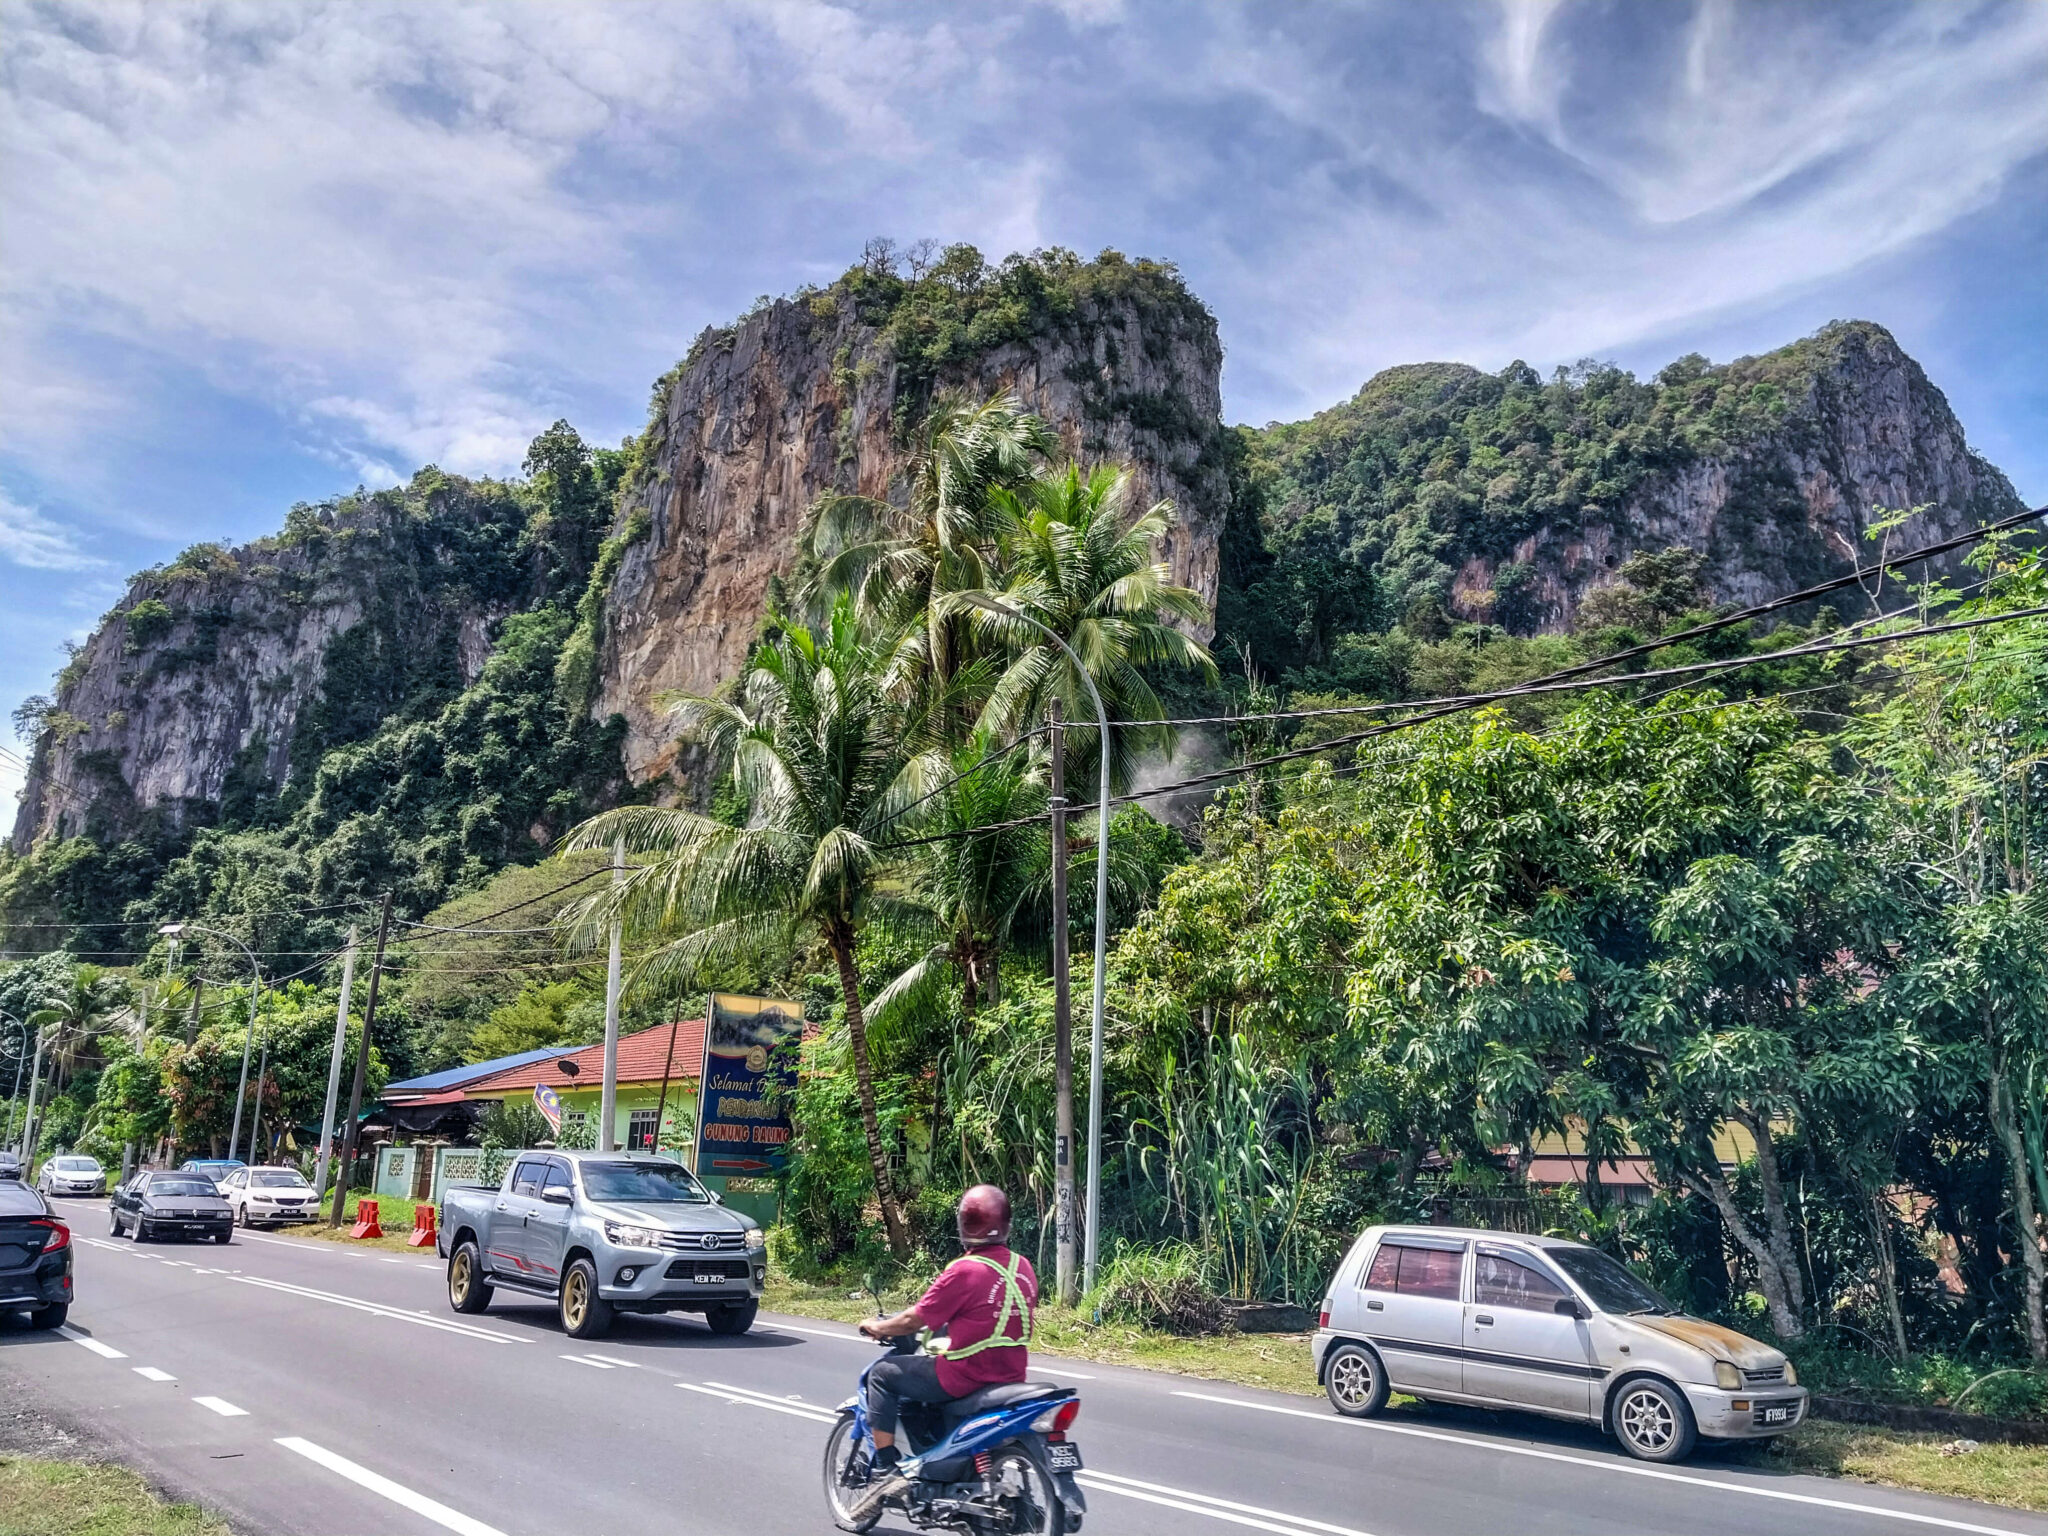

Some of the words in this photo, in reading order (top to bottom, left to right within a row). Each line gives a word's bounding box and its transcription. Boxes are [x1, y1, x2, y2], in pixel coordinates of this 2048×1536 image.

[708, 1072, 754, 1092] Selamat
[756, 1077, 798, 1095] Dang
[704, 1123, 750, 1142] GUNUNG
[752, 1126, 791, 1144] BALING
